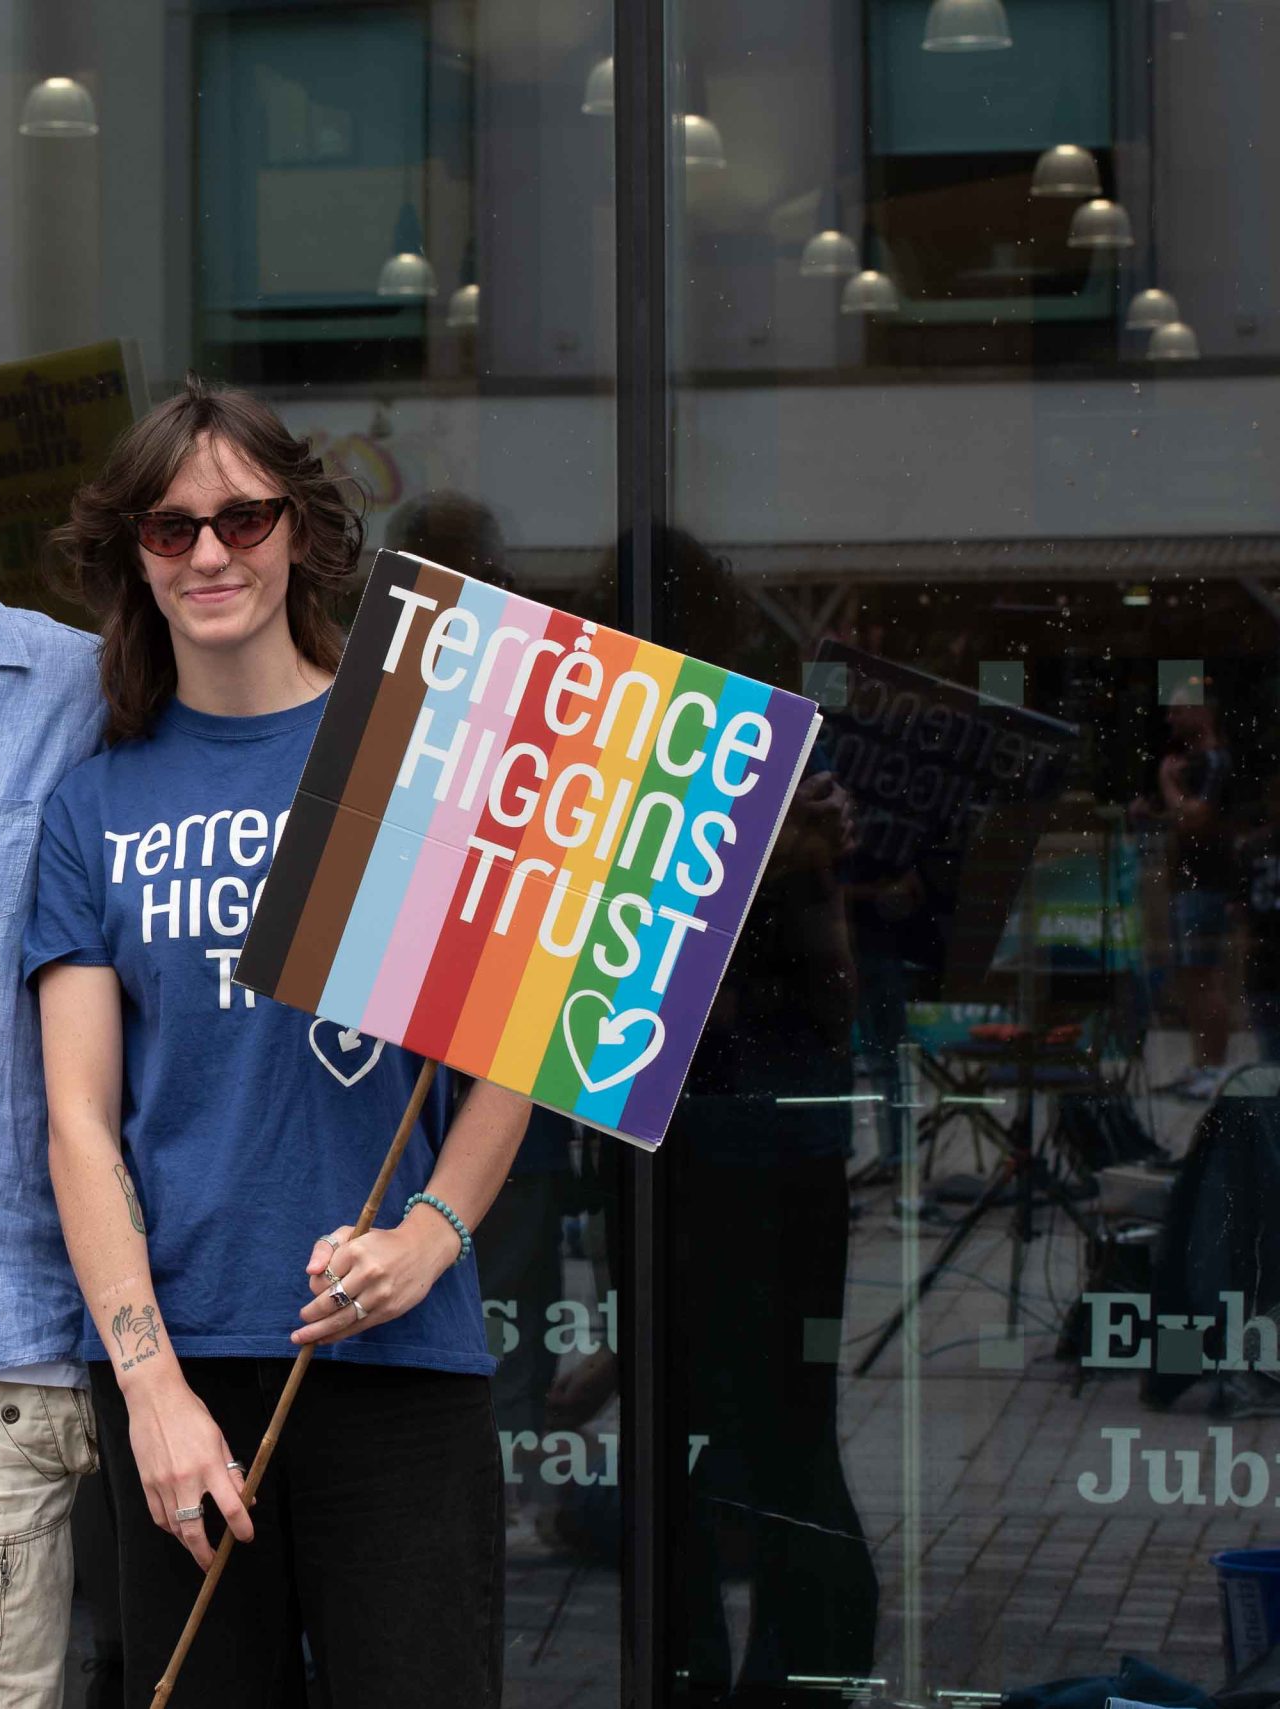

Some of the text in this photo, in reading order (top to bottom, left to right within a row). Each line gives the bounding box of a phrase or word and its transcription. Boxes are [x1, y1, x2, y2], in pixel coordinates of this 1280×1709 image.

[382, 586, 773, 797] Terrence
[105, 808, 291, 884] Terre
[142, 876, 268, 943] HIG
[1077, 1426, 1280, 1507] Jub
